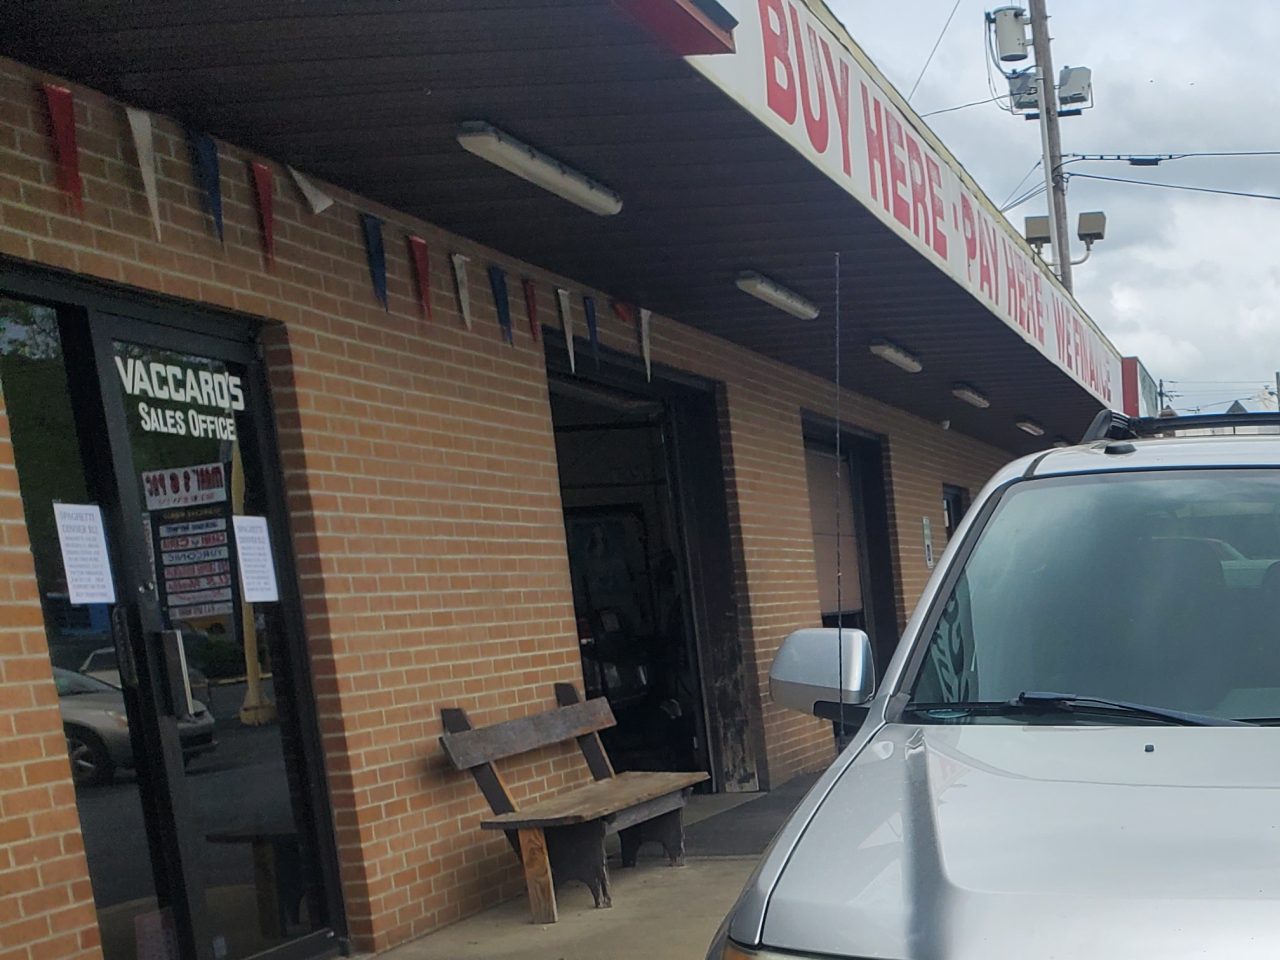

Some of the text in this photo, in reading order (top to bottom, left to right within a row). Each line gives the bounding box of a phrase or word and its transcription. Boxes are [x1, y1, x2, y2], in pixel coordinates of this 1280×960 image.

[757, 0, 852, 178] BUY
[860, 79, 948, 262] HERE
[960, 190, 1000, 306] PAY
[1002, 236, 1045, 346] HERE
[1051, 291, 1074, 371] WE
[138, 402, 237, 440] SALES OFFICE
